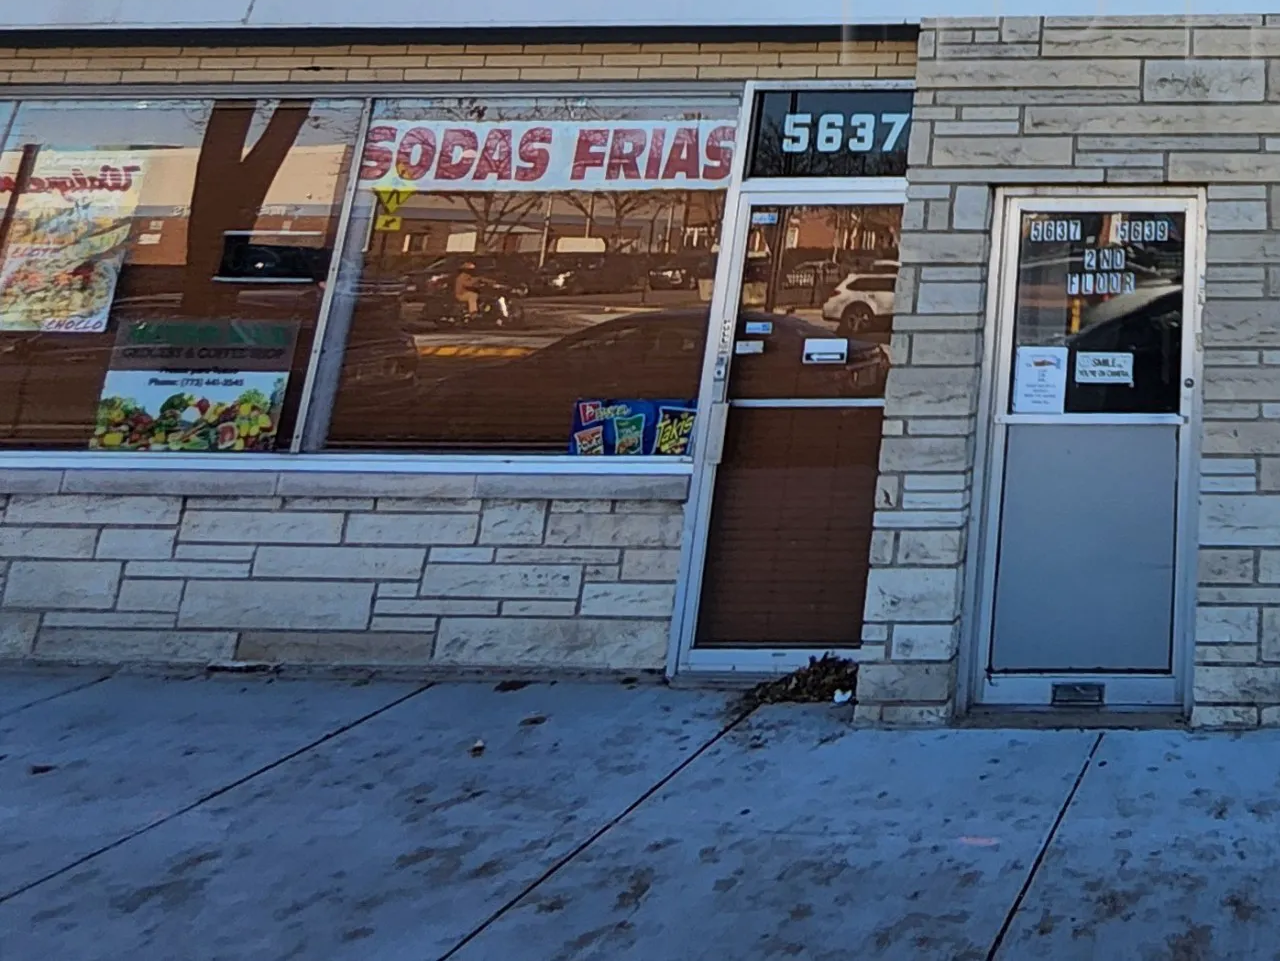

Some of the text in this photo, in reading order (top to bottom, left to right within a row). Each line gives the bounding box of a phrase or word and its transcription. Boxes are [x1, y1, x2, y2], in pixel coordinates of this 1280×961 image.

[782, 113, 910, 152] 5637
[359, 125, 737, 181] SODAS FRIAS
[1033, 221, 1080, 240] 5637
[1118, 221, 1167, 240] 5639
[1067, 273, 1135, 294] FLOOR
